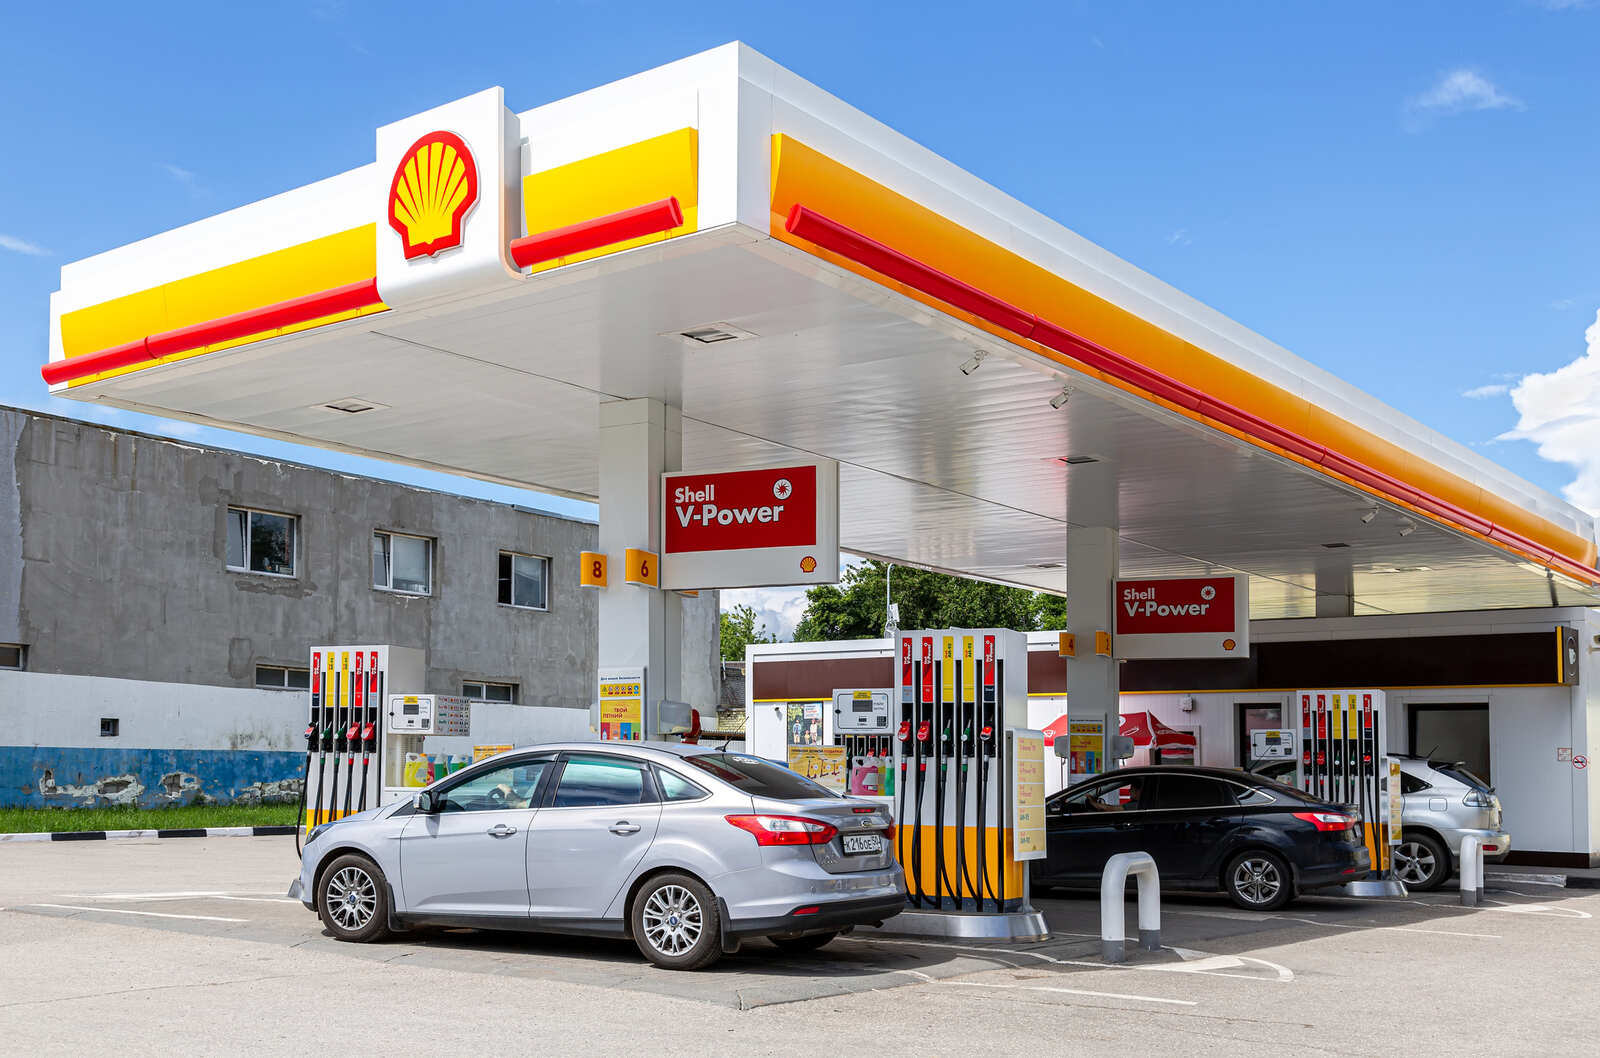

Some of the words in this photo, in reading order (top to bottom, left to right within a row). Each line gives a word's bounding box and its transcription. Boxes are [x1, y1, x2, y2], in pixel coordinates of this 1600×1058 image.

[674, 484, 715, 504] Shell
[674, 503, 785, 528] V-Power
[592, 560, 602, 578] 8
[640, 559, 649, 577] 6
[1123, 587, 1156, 600] Shell
[1124, 600, 1210, 617] V-Power
